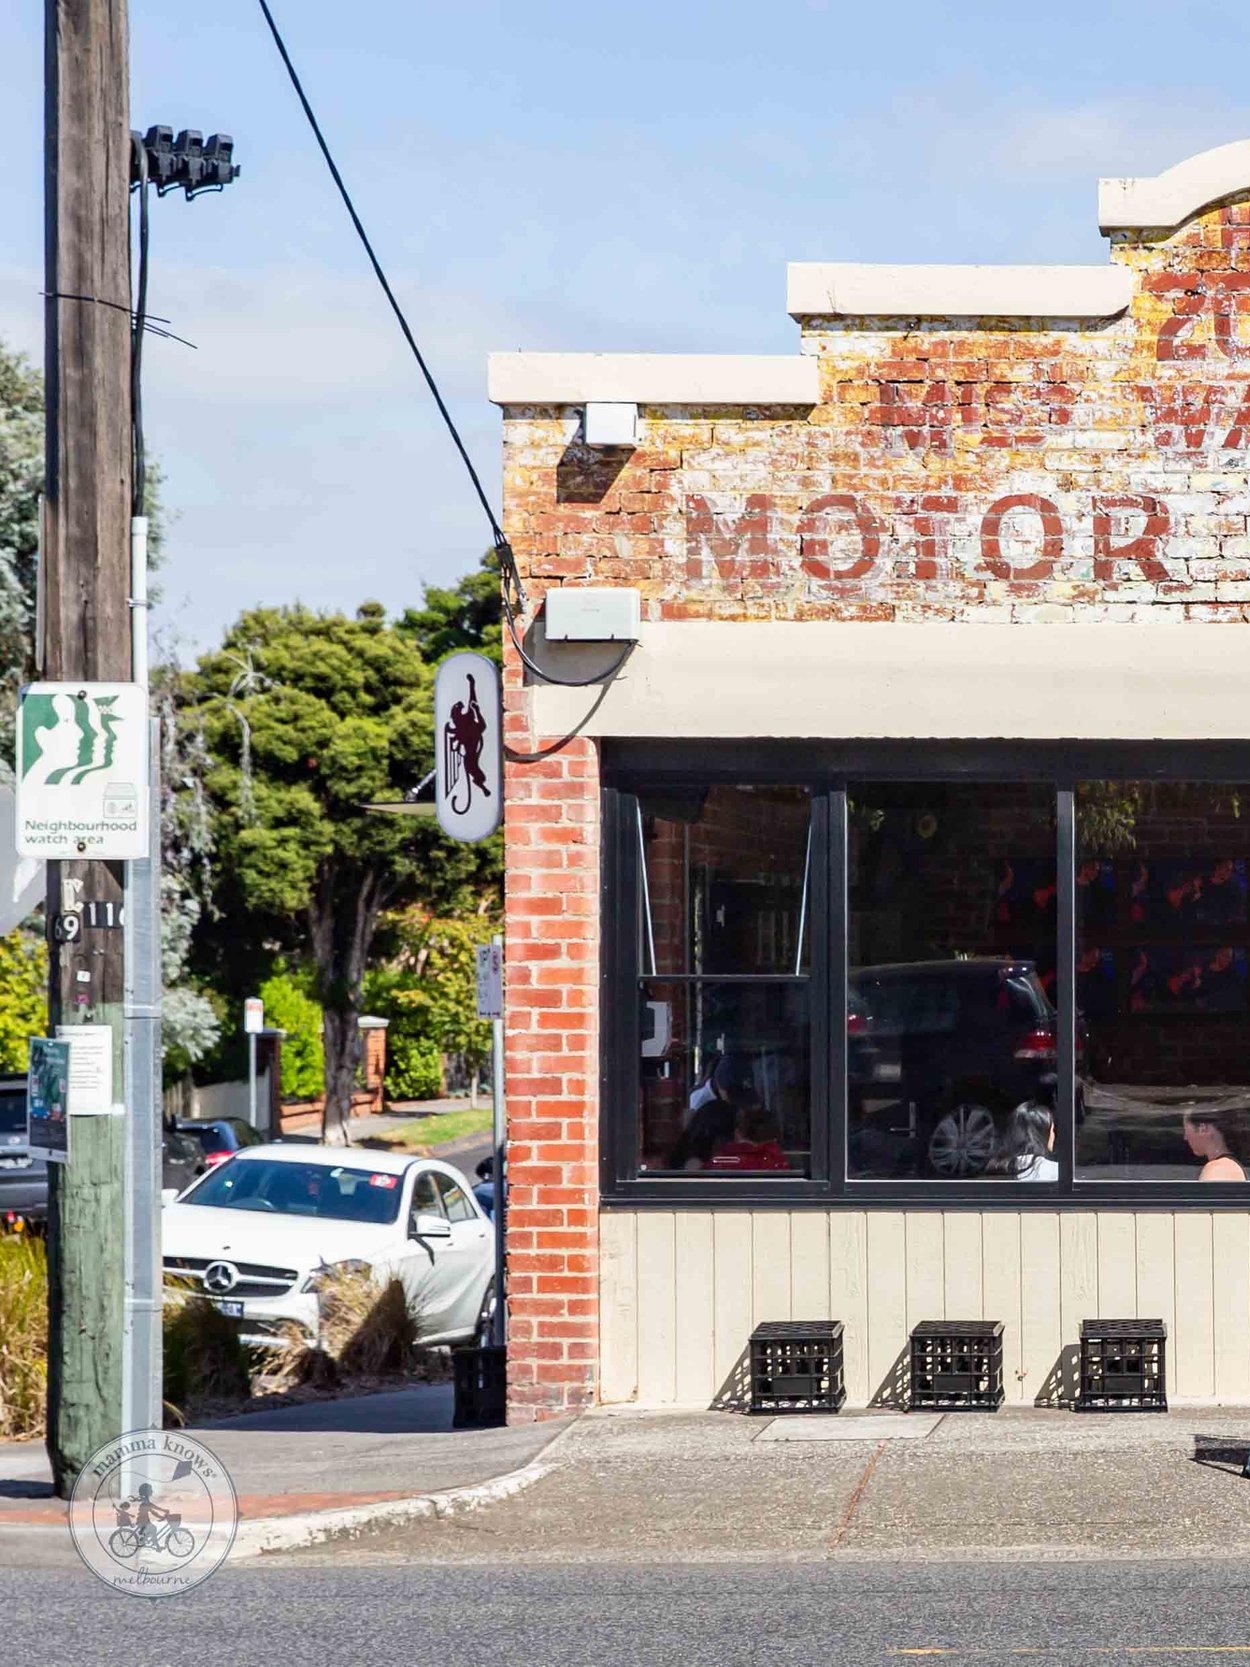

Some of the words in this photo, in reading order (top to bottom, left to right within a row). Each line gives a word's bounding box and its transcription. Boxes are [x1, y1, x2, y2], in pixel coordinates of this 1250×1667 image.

[684, 493, 1173, 581] MOTOR
[25, 819, 138, 835] Neighbourhood
[25, 835, 68, 845] watch
[73, 836, 104, 845] area
